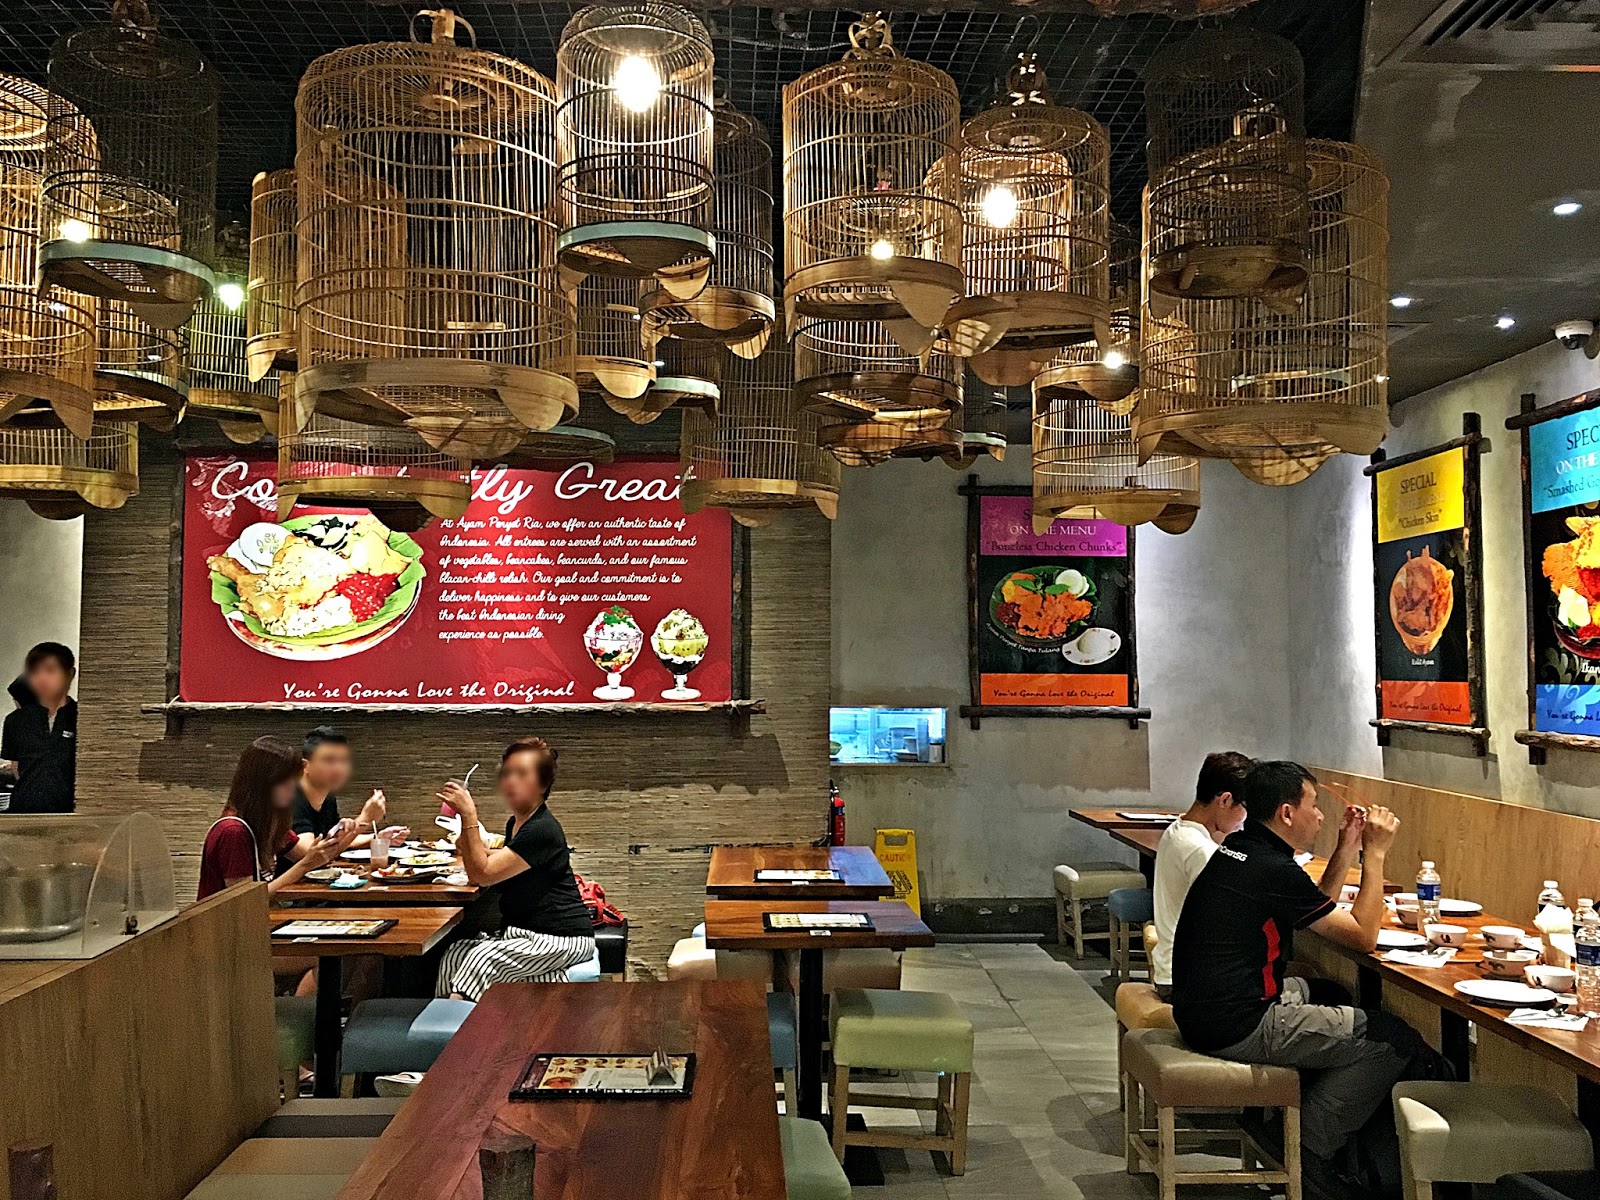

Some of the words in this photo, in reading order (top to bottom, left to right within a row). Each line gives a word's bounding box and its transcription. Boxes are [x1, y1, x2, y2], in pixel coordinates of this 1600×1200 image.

[1566, 424, 1600, 451] SPEC
[1556, 458, 1574, 475] ON
[1575, 451, 1599, 470] THE
[1400, 472, 1437, 494] SPECIAL
[440, 519, 454, 529] At
[456, 516, 486, 532] Ayam
[523, 516, 543, 530] Ria,
[545, 520, 561, 529] we
[561, 518, 586, 532] offer
[588, 520, 602, 529] an
[603, 517, 647, 529] authentic
[648, 517, 672, 529] taste
[674, 518, 686, 532] of
[1009, 525, 1029, 535] ON
[1060, 525, 1097, 535] MENU
[439, 534, 491, 547] Indonesia.
[494, 534, 512, 547] All
[513, 535, 548, 547] entrees
[549, 539, 567, 547] are
[567, 534, 601, 547] served
[602, 534, 625, 547] with
[626, 539, 641, 547] an
[642, 535, 697, 547] assortment
[1035, 541, 1076, 552] Chicken
[1078, 541, 1122, 552] Chunks"
[439, 554, 451, 569] of
[453, 552, 503, 569] vegetables,
[505, 552, 555, 566] beancakes,
[556, 552, 607, 566] beancurds,
[609, 552, 629, 565] and
[630, 557, 648, 565] our
[649, 554, 688, 568] famous
[499, 571, 529, 583] relish.
[532, 570, 553, 583] Our
[554, 571, 578, 587] goal
[579, 571, 599, 583] and
[600, 572, 657, 583] commitment
[659, 573, 670, 583] is
[671, 572, 682, 583] to
[439, 589, 472, 602] deliver
[474, 590, 524, 606] happiness
[525, 589, 546, 602] and
[547, 590, 558, 602] to
[559, 592, 580, 606] give
[580, 593, 599, 602] our
[601, 590, 651, 602] customers
[439, 608, 455, 620] the
[456, 608, 477, 620] best
[478, 608, 534, 620] Indonesian
[535, 608, 565, 624] dining
[439, 630, 486, 643] experience
[487, 631, 501, 639] as
[501, 626, 544, 643] possible.
[282, 682, 340, 699] You're
[347, 682, 410, 700] Gonna
[417, 681, 453, 698] Love
[459, 681, 487, 698] the
[493, 680, 576, 702] Original
[993, 689, 1017, 698] You're
[1019, 689, 1046, 698] Gonna
[1048, 689, 1064, 698] Love
[1066, 689, 1078, 698] the
[1080, 689, 1115, 700] Original
